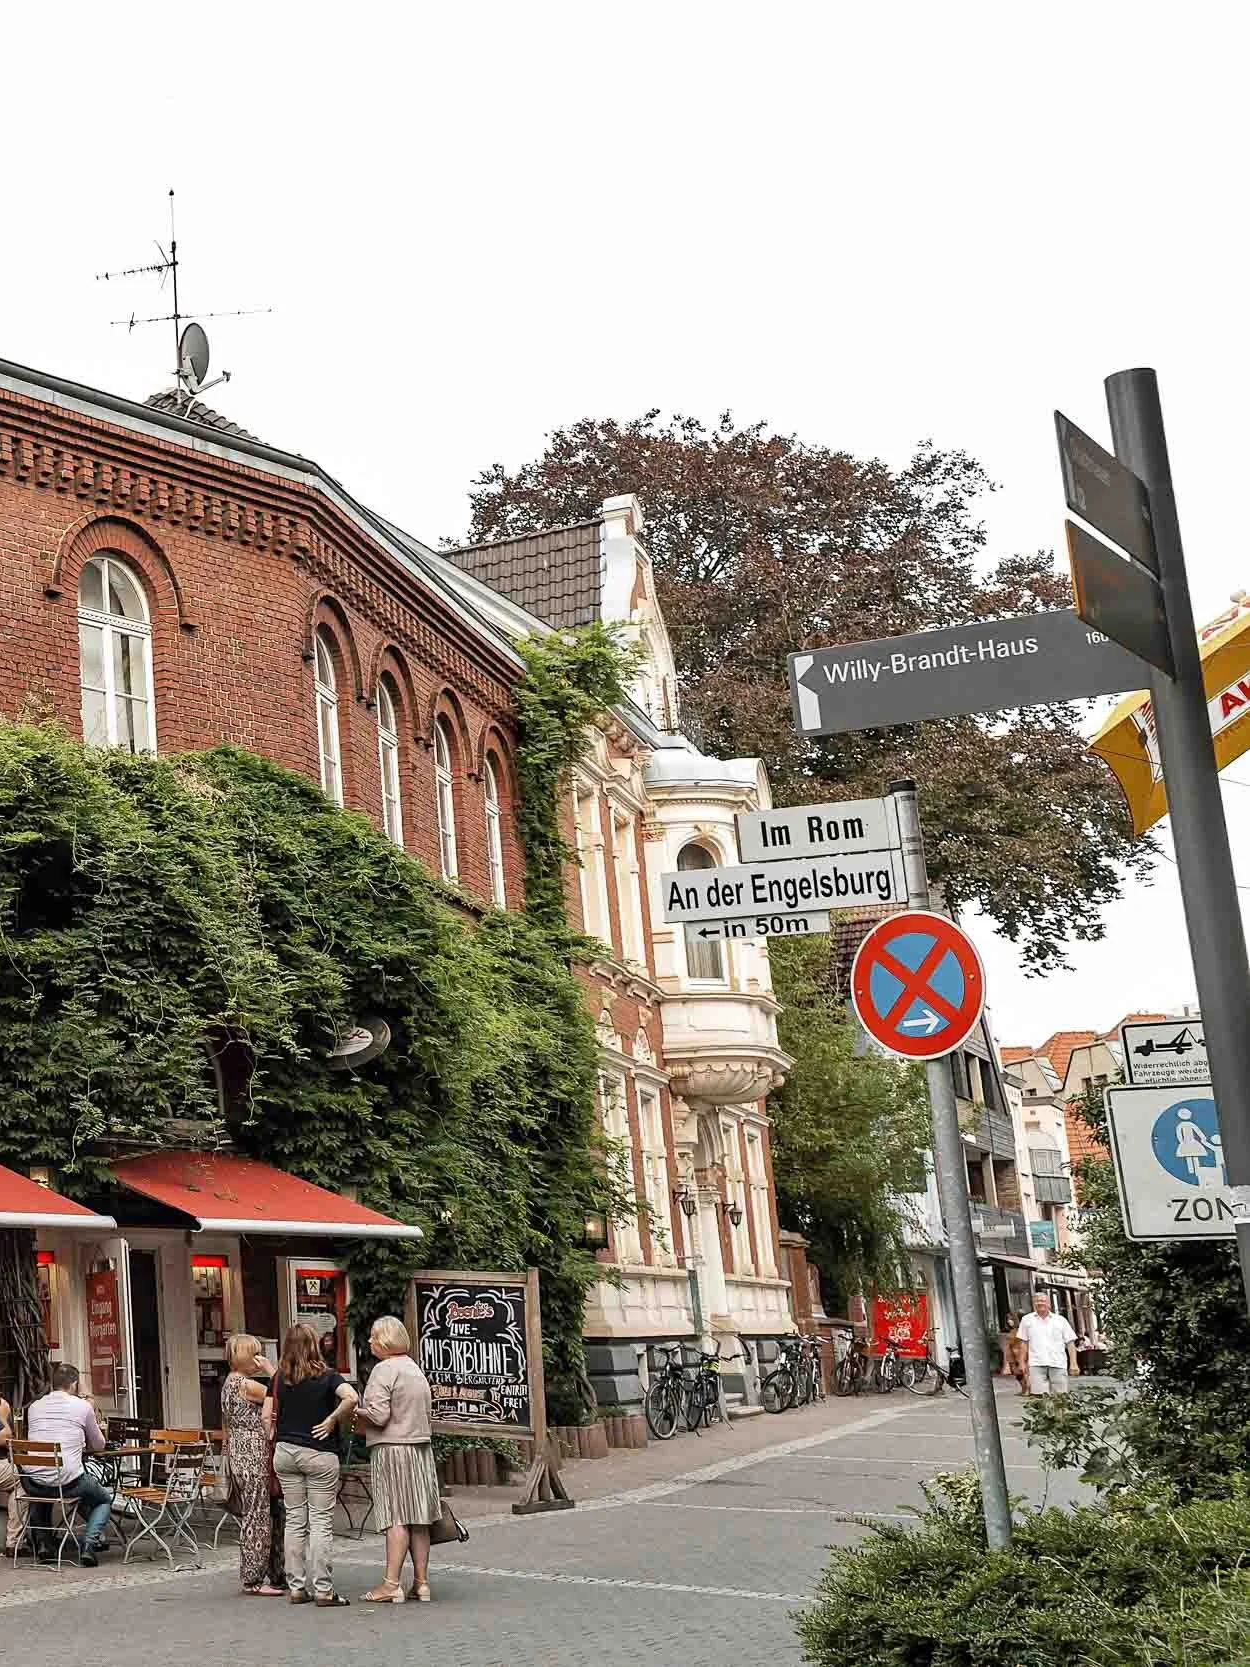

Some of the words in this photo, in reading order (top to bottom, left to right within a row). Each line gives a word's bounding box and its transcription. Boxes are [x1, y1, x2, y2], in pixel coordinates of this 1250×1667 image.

[822, 636, 1039, 685] Willy-Brandt-Haus
[760, 820, 791, 848] Im
[807, 815, 864, 844] Rom
[668, 881, 699, 911] An
[706, 877, 744, 907] der
[751, 866, 892, 909] Engelsburg
[723, 919, 746, 937] in
[755, 916, 809, 935] 50m
[1133, 1069, 1175, 1077] Fahrzeuge
[1171, 1197, 1235, 1222] ZON
[424, 1338, 515, 1376] MUSIKBÜHNE
